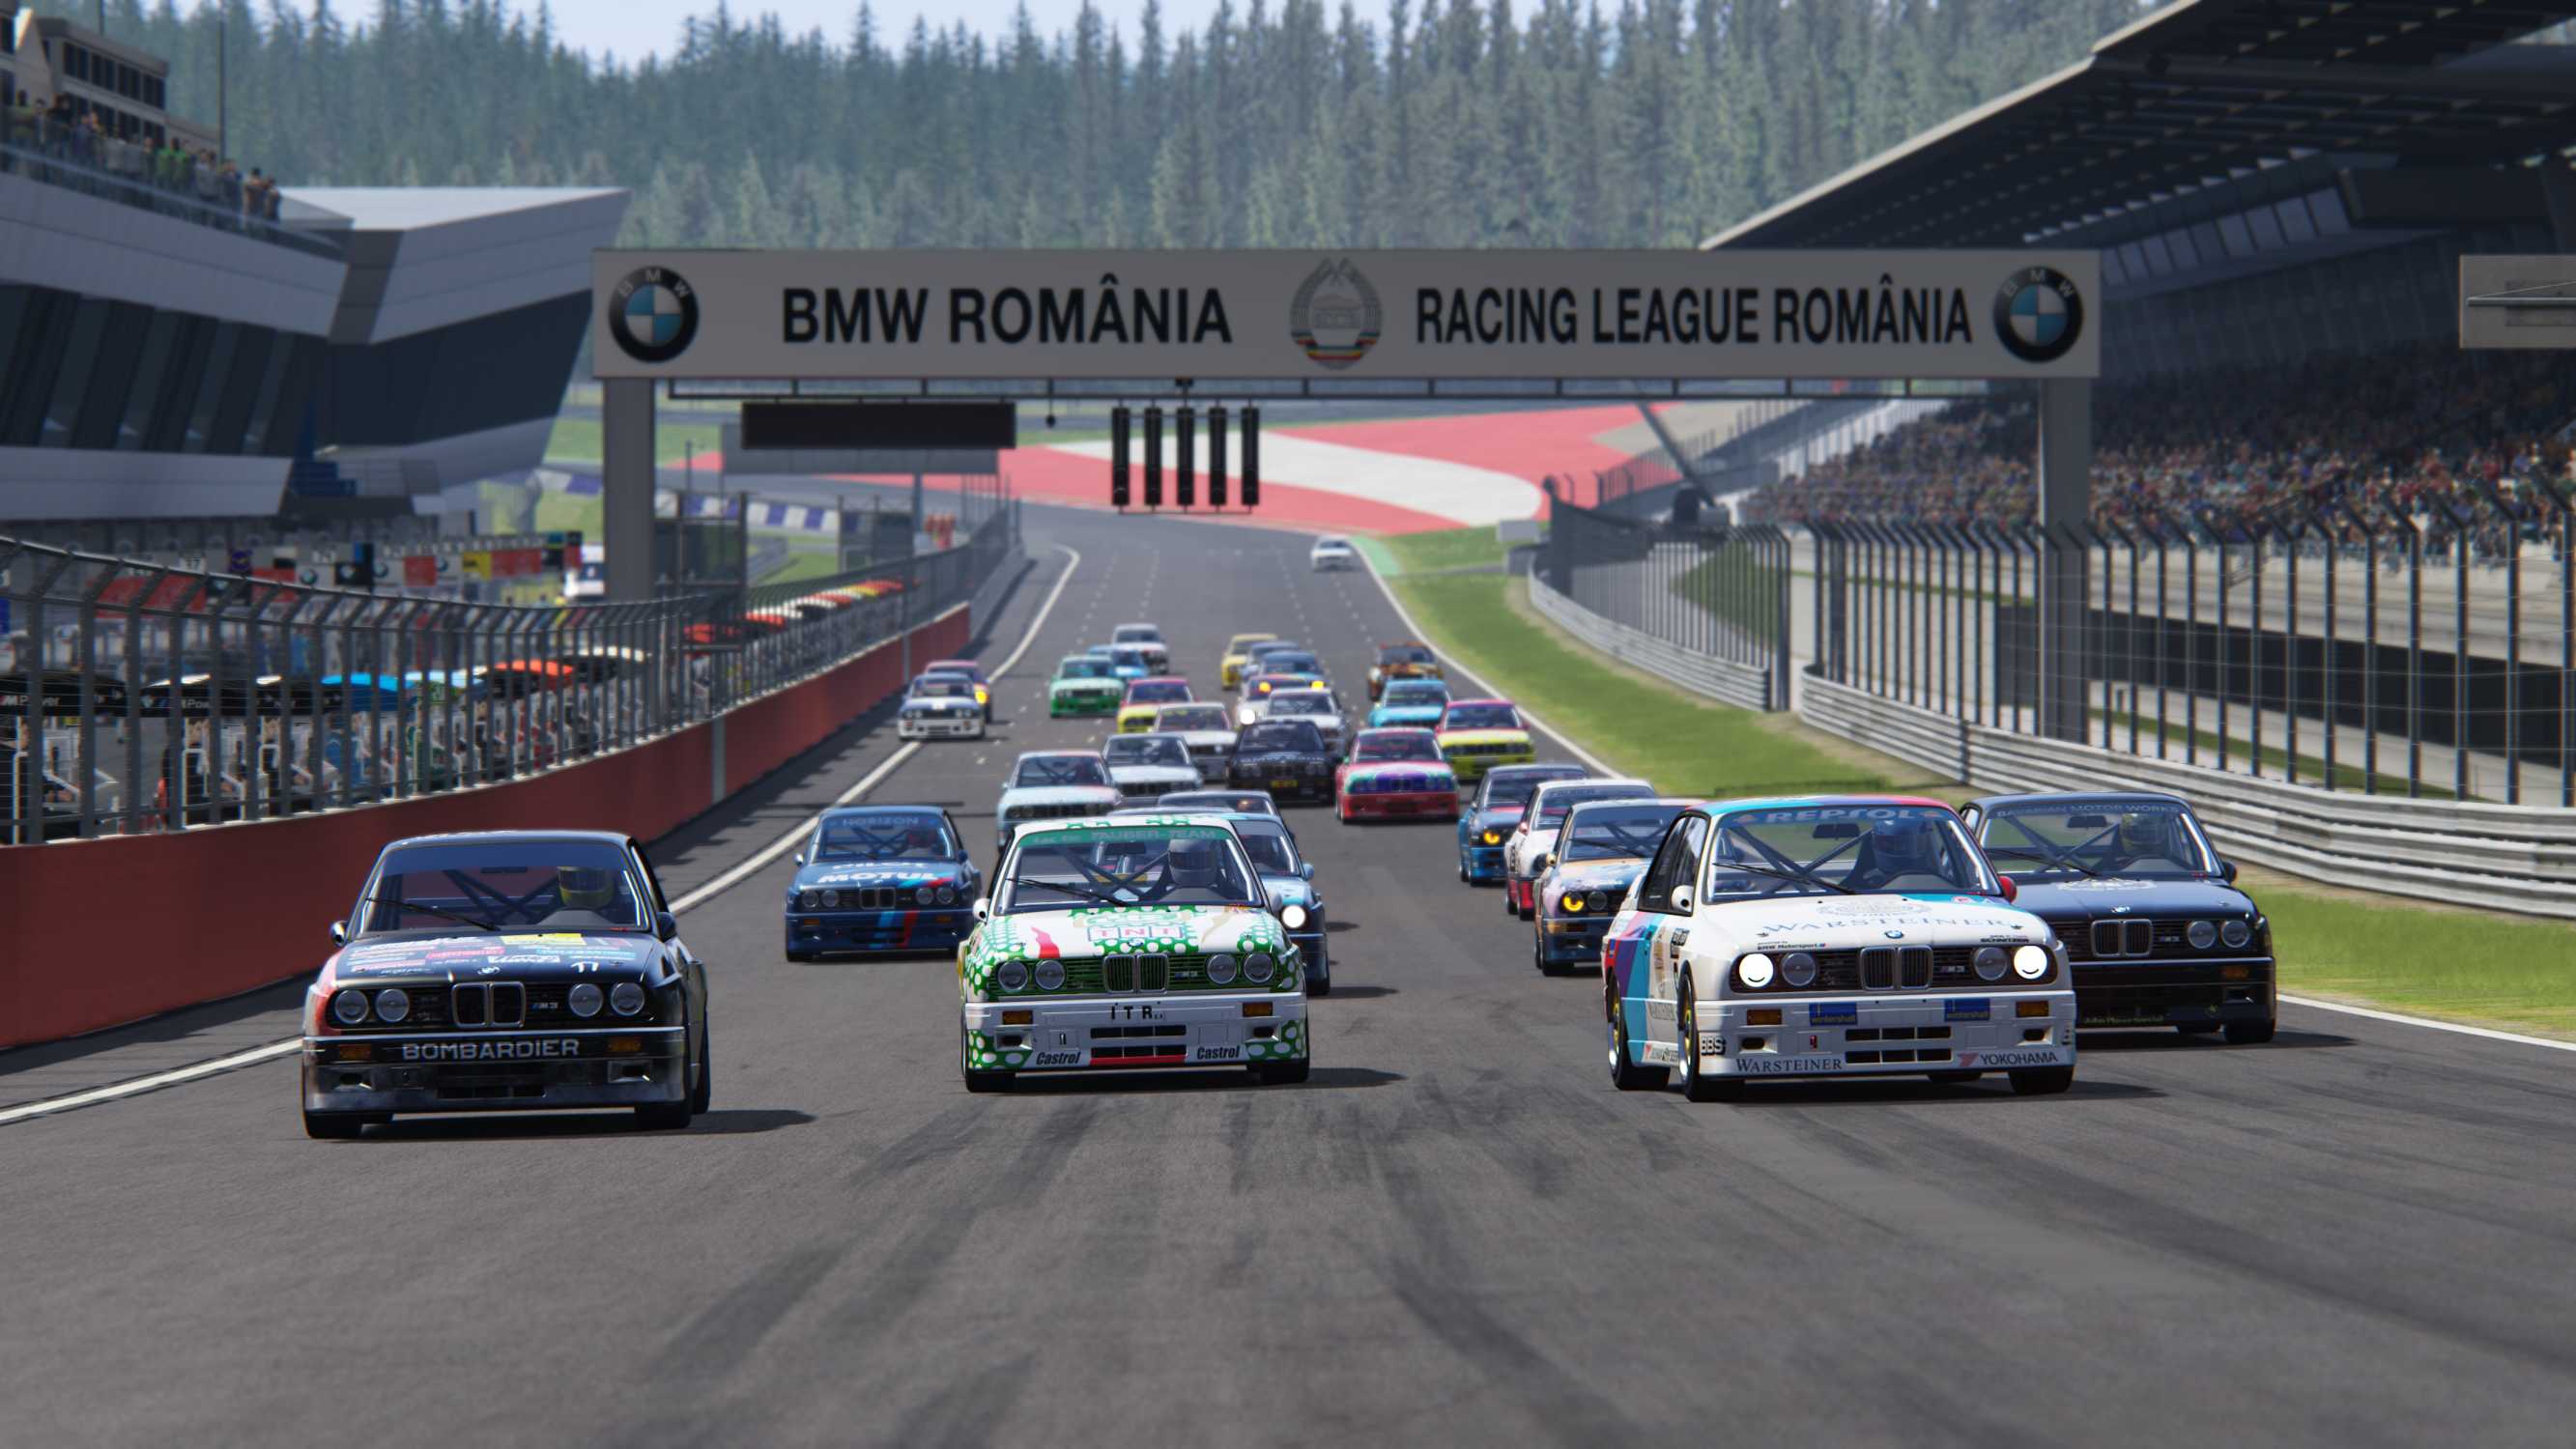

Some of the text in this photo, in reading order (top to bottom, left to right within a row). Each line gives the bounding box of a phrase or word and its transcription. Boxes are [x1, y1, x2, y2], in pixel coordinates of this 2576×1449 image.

[783, 272, 1233, 345] BMW ROMÂNIA
[1417, 272, 1972, 345] RACING LEAGUE ROMÂNIA
[1765, 808, 1917, 823] REPSOL
[2070, 804, 2124, 812] MOTOR
[1167, 830, 1216, 839] TEAM
[816, 872, 939, 884] MOTUL
[1762, 918, 2014, 933] WARSTEINER
[402, 1038, 580, 1061] BOMBARDIER
[1196, 1045, 1241, 1061] Castrol
[1701, 1037, 1726, 1056] BBS
[1036, 1051, 1082, 1066] Castrol
[1735, 1058, 1844, 1073] WARSTEINER
[1981, 1051, 2058, 1066] YOKOHAMA
